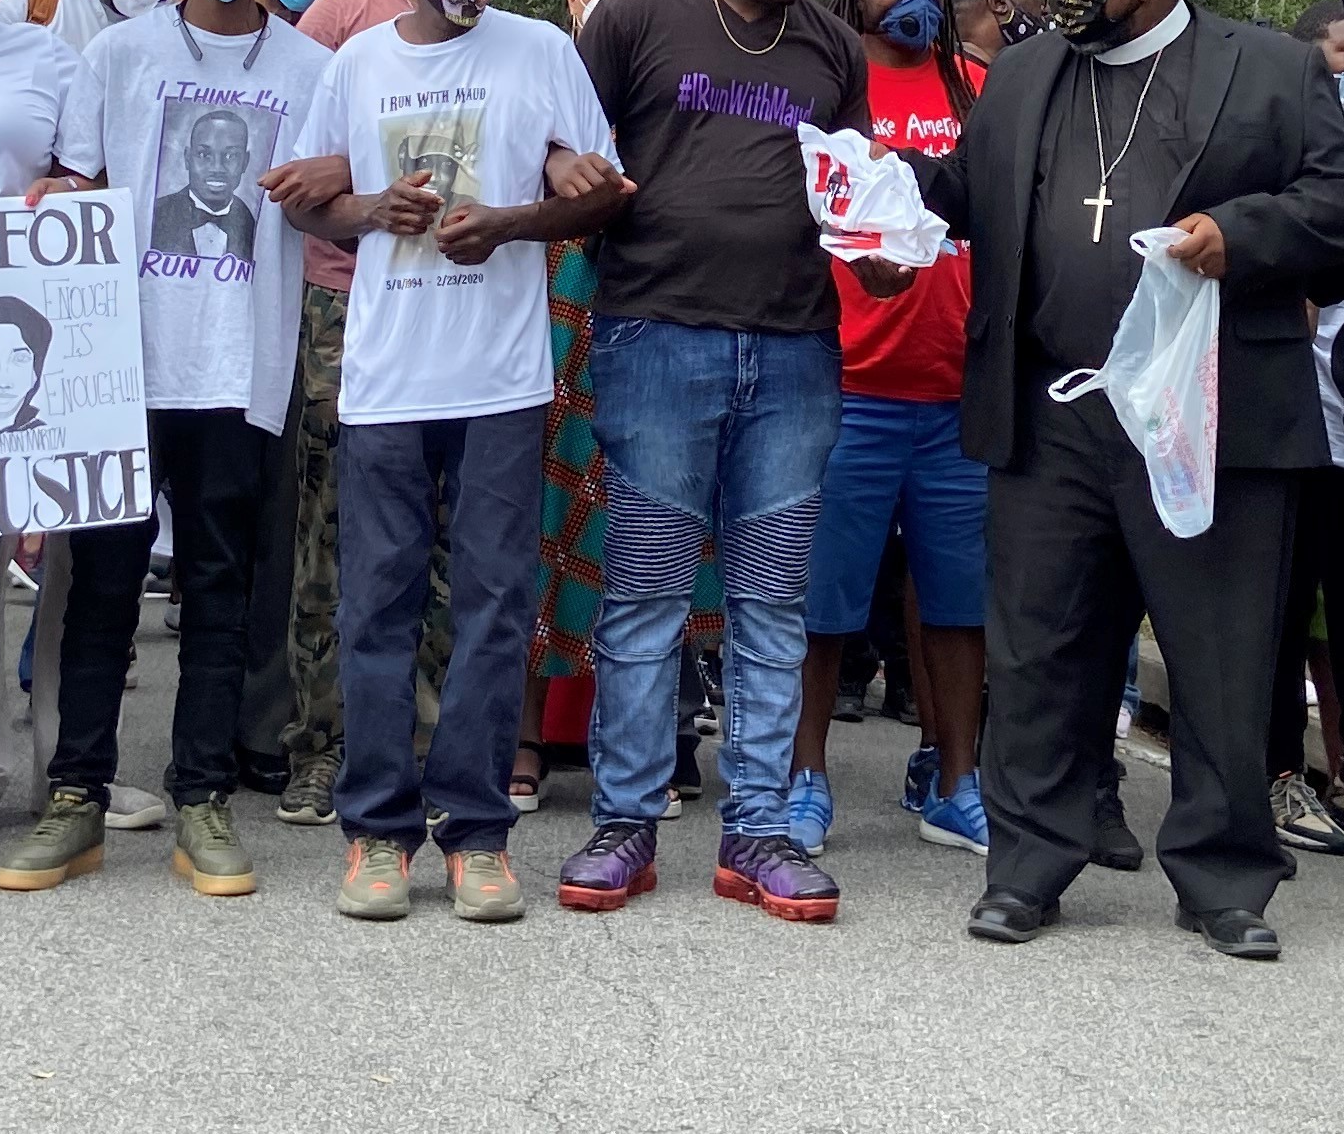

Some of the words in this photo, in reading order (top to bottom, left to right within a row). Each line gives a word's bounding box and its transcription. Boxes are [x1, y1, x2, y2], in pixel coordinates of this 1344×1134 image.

[677, 72, 815, 130] #IRunWithMaud
[872, 117, 896, 138] ake
[140, 250, 201, 279] RUN
[436, 272, 485, 287] 2/23/2020
[43, 277, 119, 321] ENOUGH
[63, 322, 93, 360] IS
[43, 366, 141, 416] ENOUGH!!!
